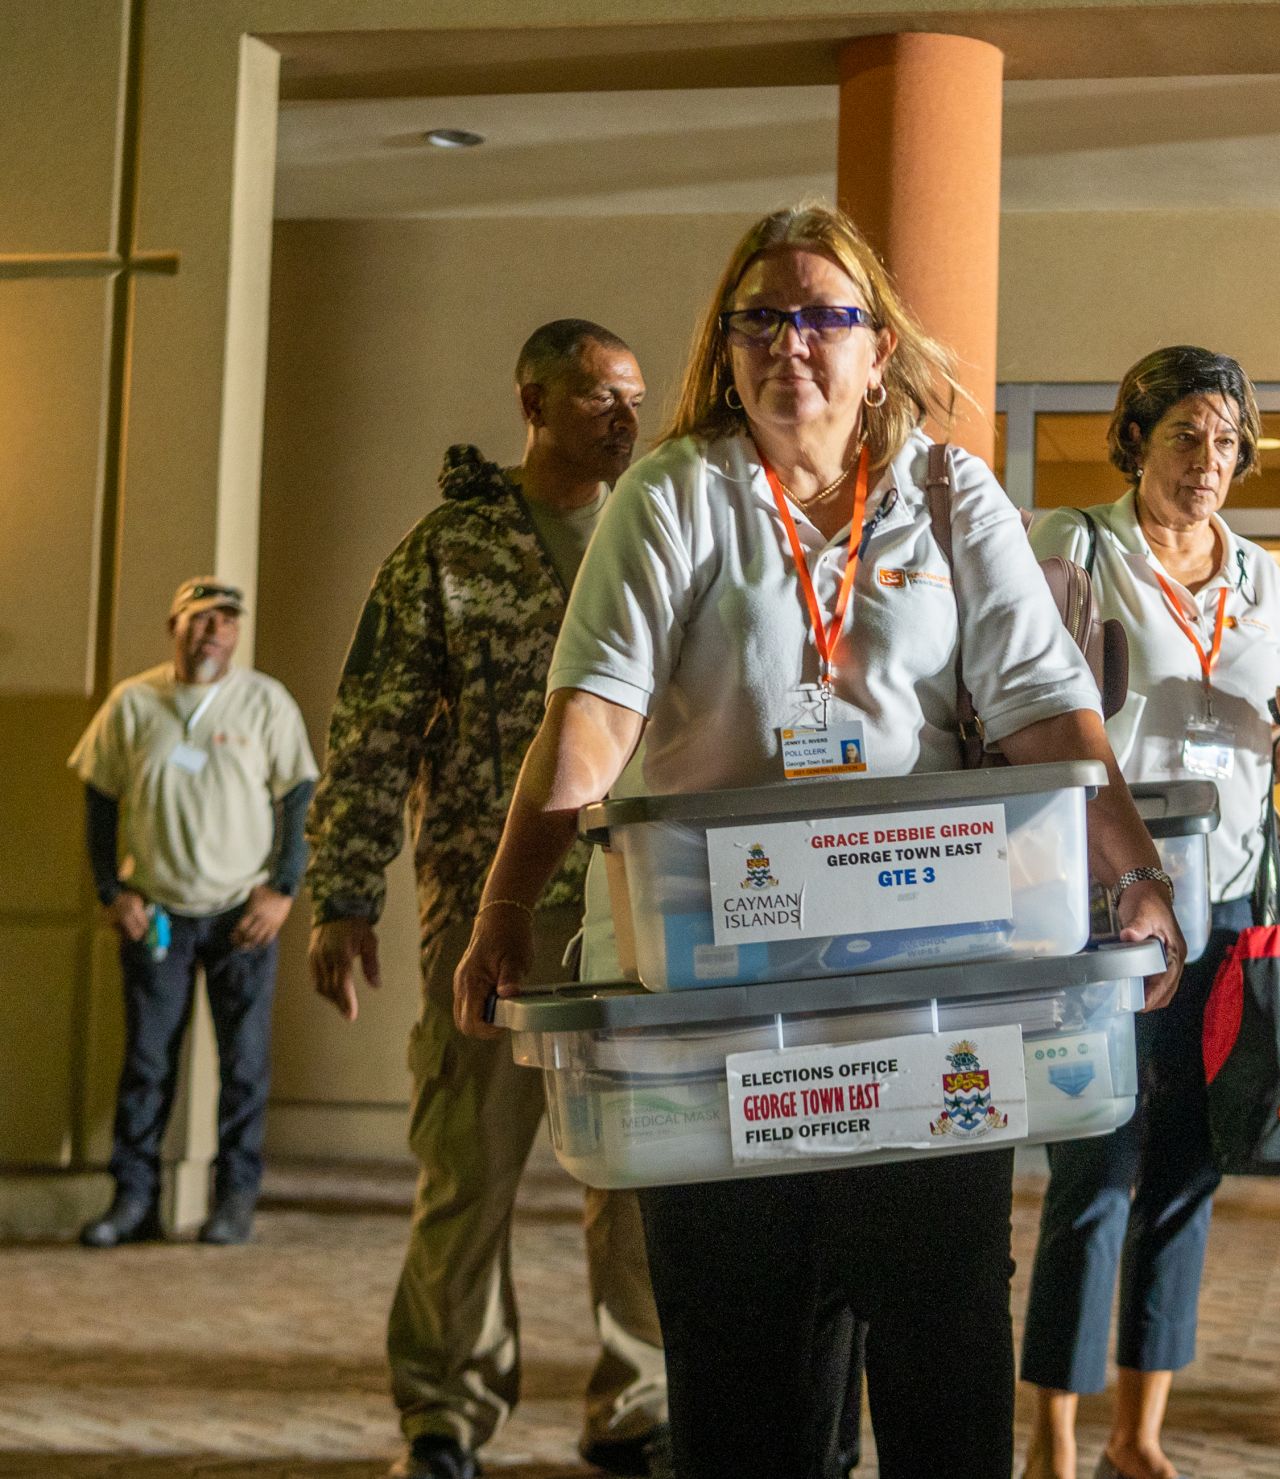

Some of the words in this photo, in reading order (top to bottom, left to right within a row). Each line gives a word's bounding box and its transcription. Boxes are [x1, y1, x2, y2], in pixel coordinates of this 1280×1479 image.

[785, 749, 802, 757] POLL
[803, 748, 827, 756] CLERK
[811, 832, 869, 849] GRACE
[874, 826, 935, 844] DEBBIE
[940, 821, 994, 840] GIRON
[827, 848, 892, 867] GEORGE
[895, 845, 941, 861] TOWN
[945, 842, 982, 857] EAST
[878, 868, 917, 887] GTE
[923, 867, 936, 883] 3
[724, 893, 798, 912] CAYMAN
[725, 909, 800, 929] ISLANDS
[742, 1064, 834, 1087] ELECTIONS
[839, 1059, 898, 1077] OFFICE
[743, 1091, 797, 1121] GEORGE
[801, 1086, 844, 1115] TOWN
[849, 1083, 880, 1111] EAST
[621, 1112, 678, 1128] MEDICAL
[684, 1109, 720, 1122] MASK
[745, 1126, 794, 1144] FIELD
[799, 1119, 870, 1138] OFFICER
